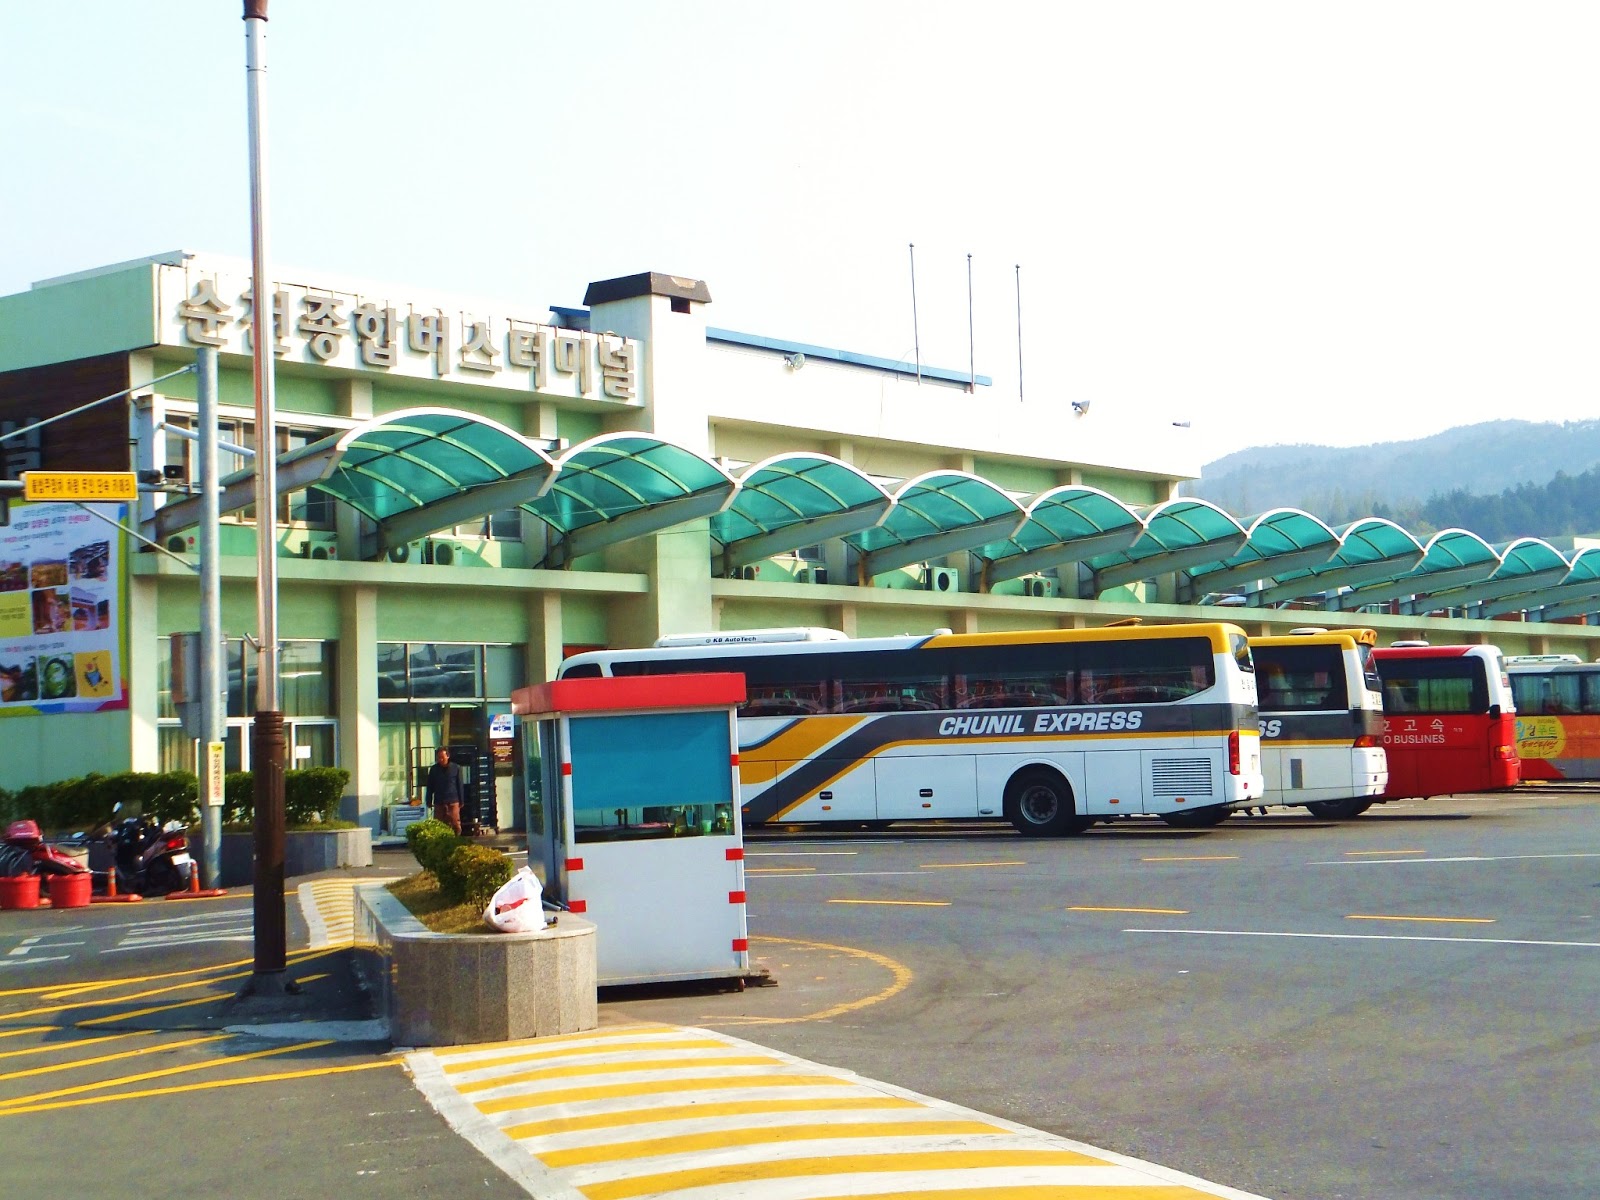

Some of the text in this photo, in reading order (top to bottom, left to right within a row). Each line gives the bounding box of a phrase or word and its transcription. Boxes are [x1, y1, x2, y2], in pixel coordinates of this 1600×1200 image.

[179, 279, 636, 400] 순천종합버스터미널
[938, 710, 1143, 736] CHUNIL EXPRESS
[1393, 734, 1446, 744] BUSLINES
